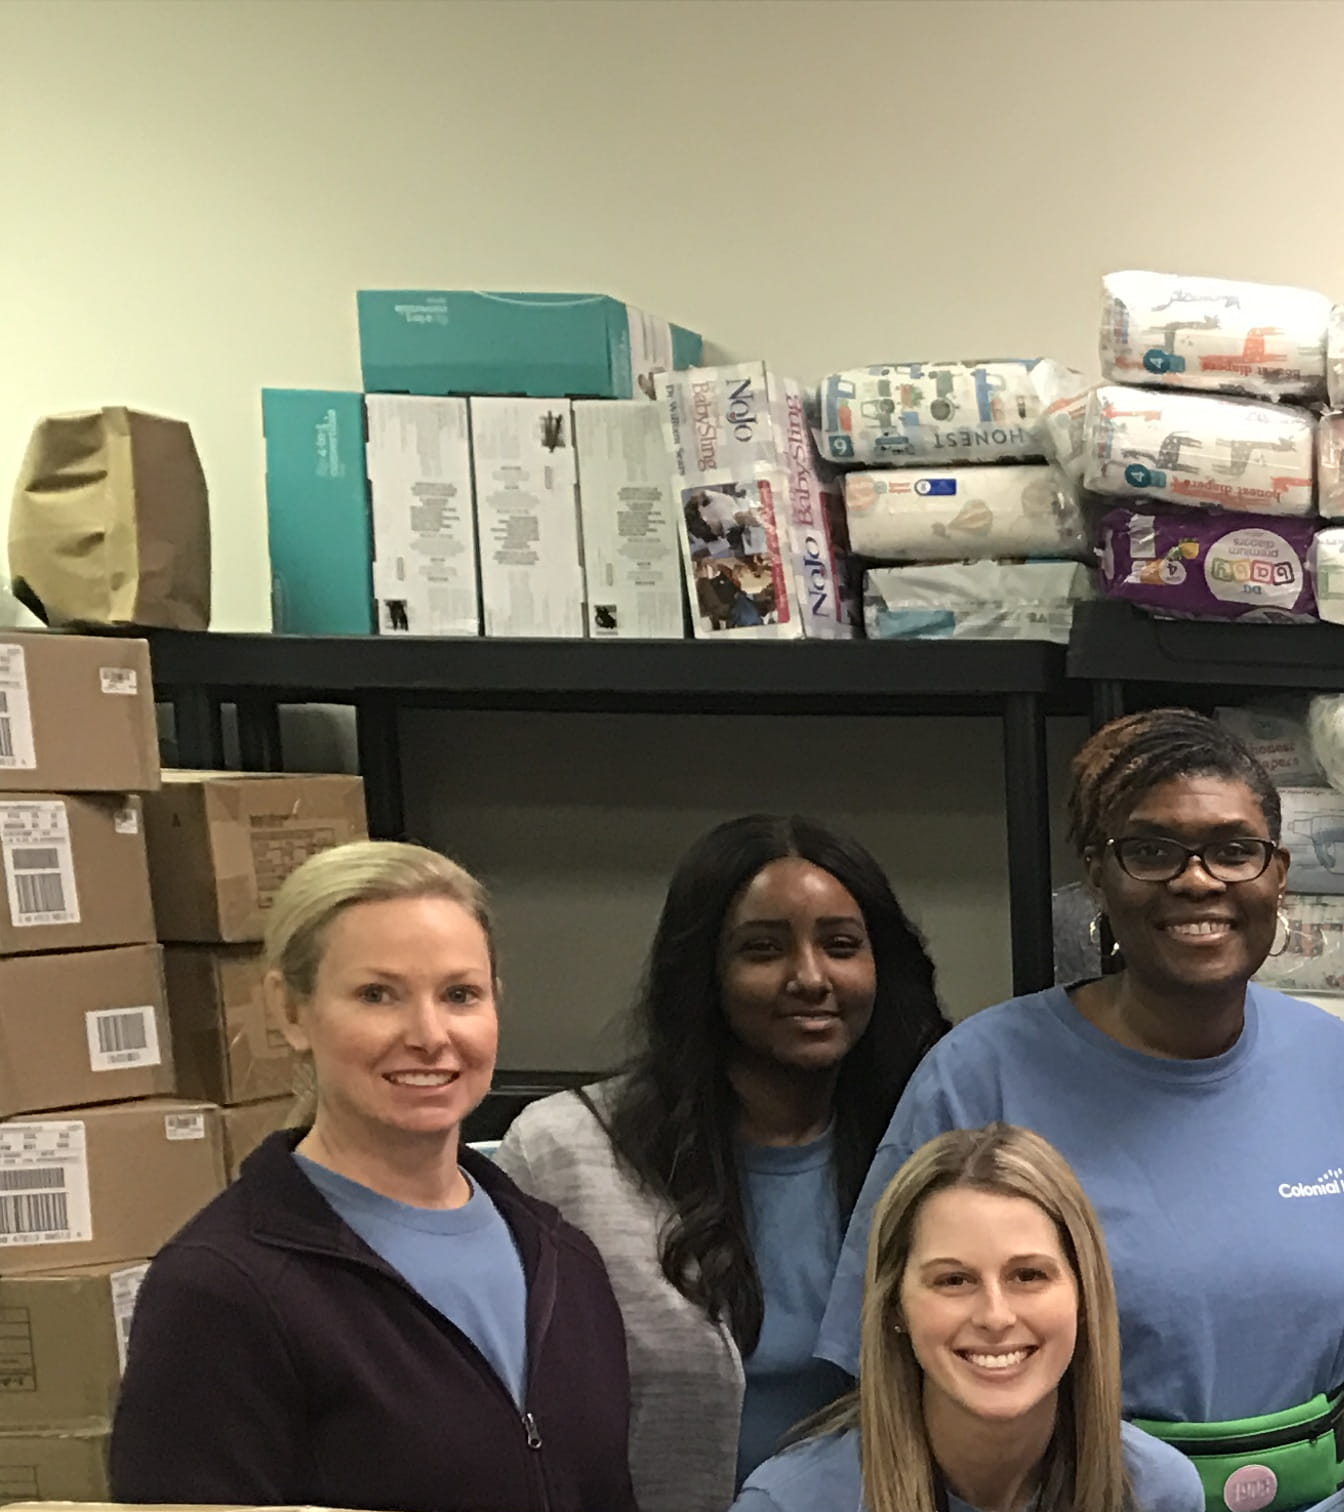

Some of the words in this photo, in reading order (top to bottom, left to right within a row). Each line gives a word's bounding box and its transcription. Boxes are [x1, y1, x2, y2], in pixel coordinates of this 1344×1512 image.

[691, 382, 718, 473] BabySling
[726, 377, 757, 443] NoJo
[785, 392, 814, 527] BabySling
[934, 427, 1025, 449] HONEST
[1239, 488, 1281, 503] honest
[803, 536, 829, 618] NoJo
[1211, 557, 1295, 587] baby
[1278, 1176, 1341, 1199] Colonial
